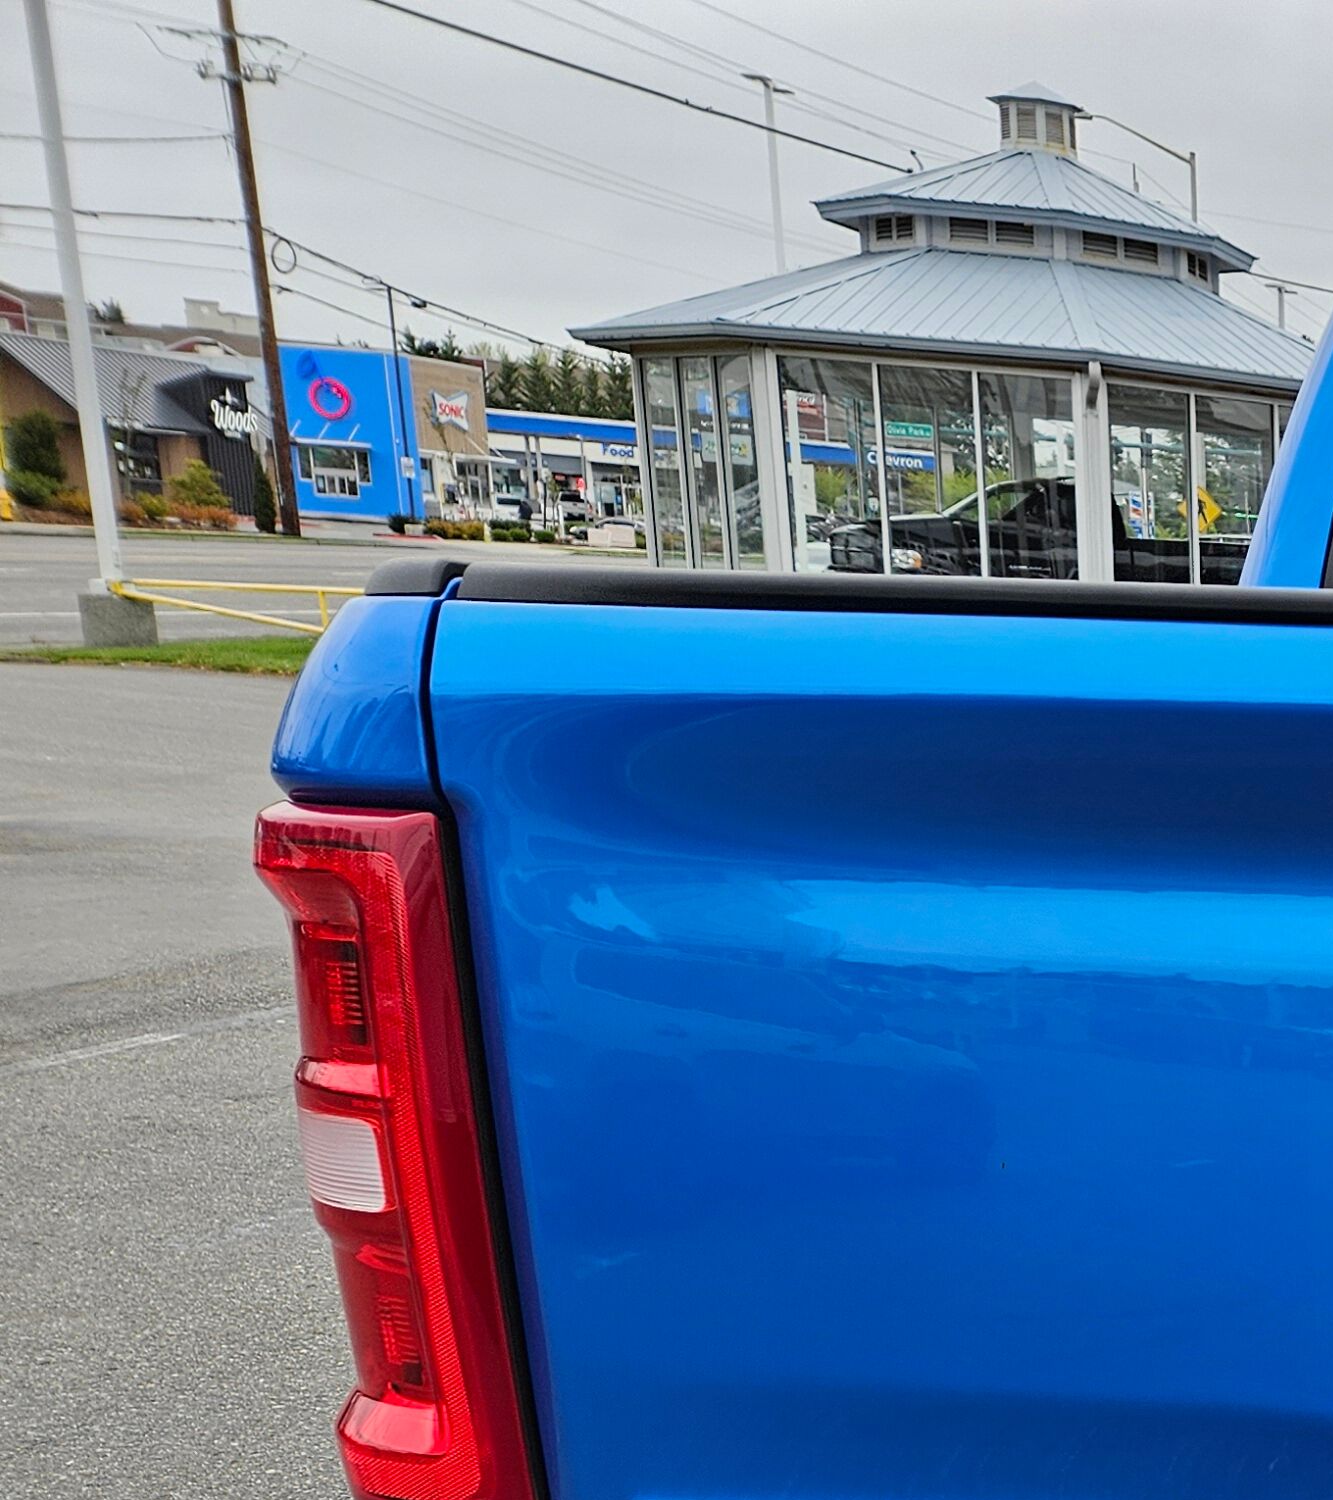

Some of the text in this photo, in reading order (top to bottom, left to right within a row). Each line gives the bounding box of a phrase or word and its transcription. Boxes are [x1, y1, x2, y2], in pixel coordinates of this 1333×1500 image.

[210, 399, 258, 433] Woods
[438, 402, 464, 419] SONIC
[601, 442, 634, 458] Food
[867, 452, 924, 470] Cevron
